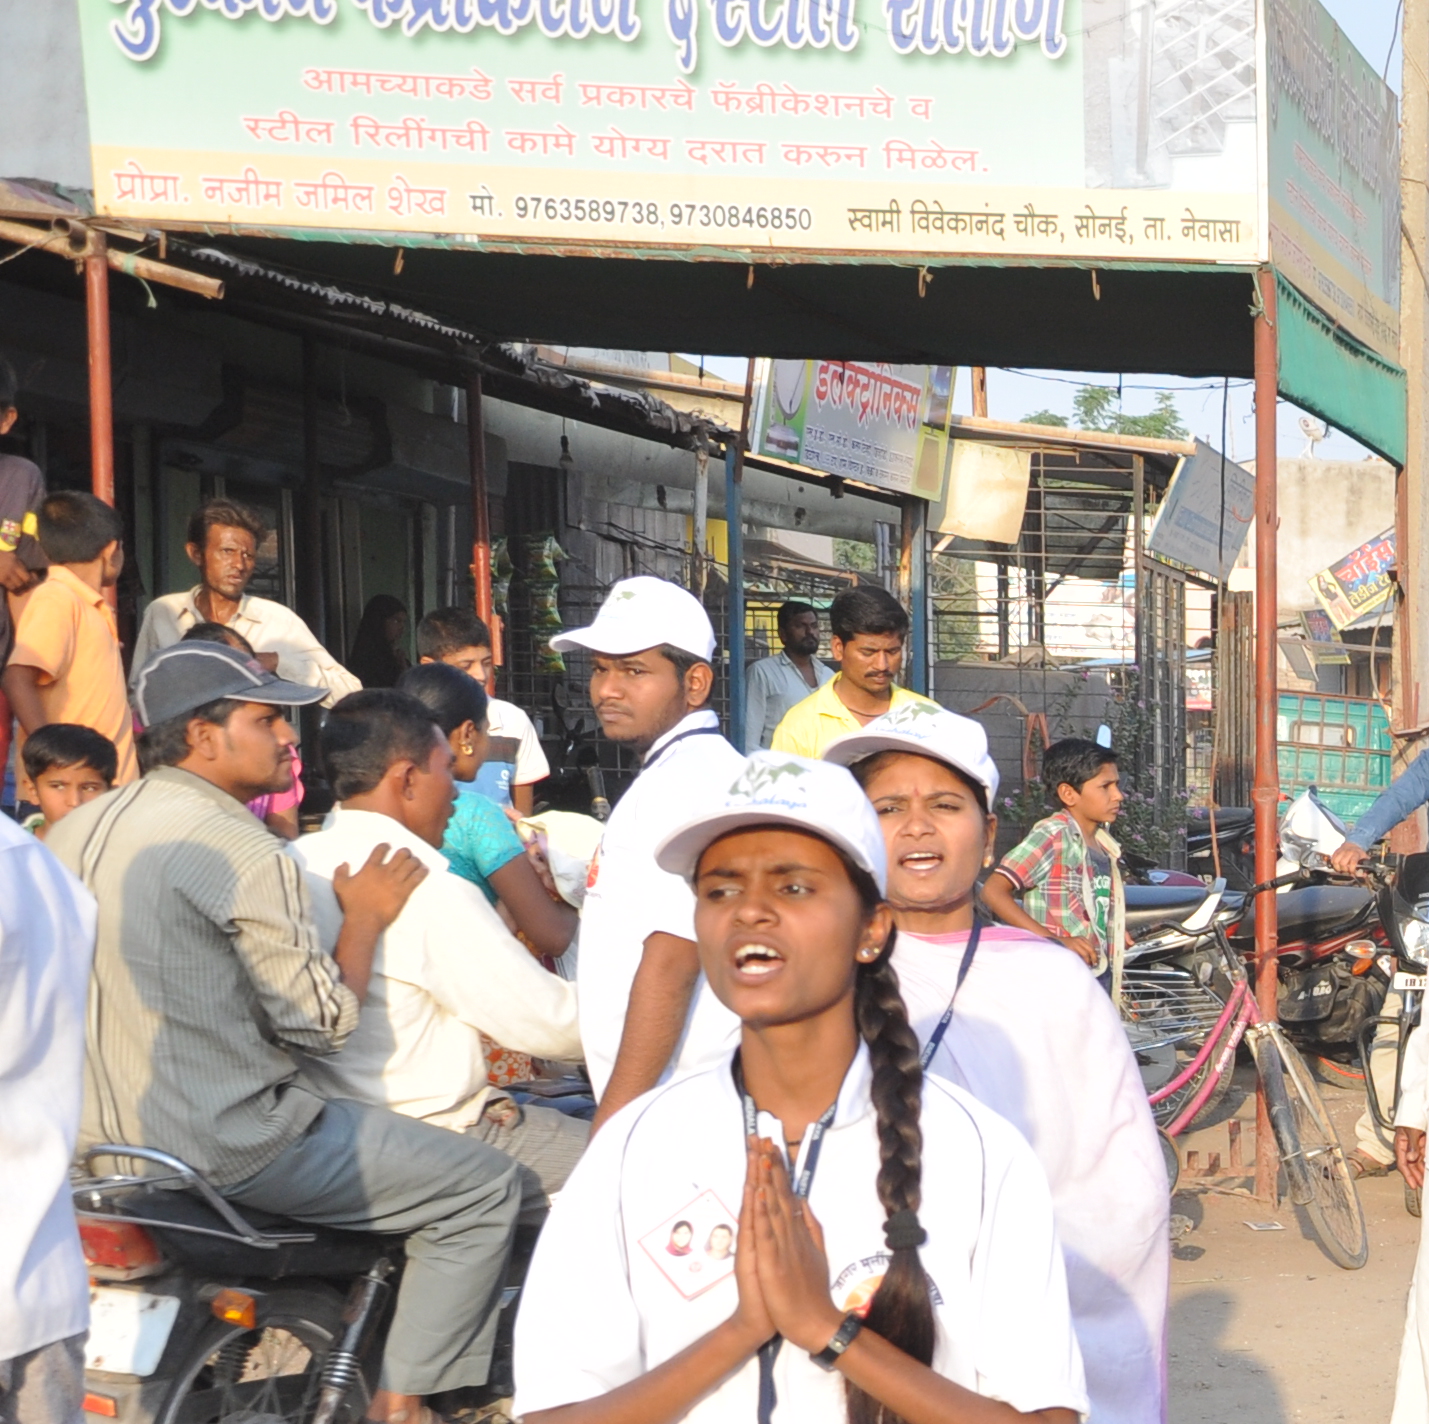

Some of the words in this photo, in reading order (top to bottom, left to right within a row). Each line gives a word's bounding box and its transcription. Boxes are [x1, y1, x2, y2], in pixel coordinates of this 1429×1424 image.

[302, 67, 494, 101] आमच्याकडे
[508, 73, 563, 105] सर्व
[578, 77, 696, 112] प्रकारचे
[711, 81, 896, 121] फॅब्रीकेशनचे
[909, 96, 934, 121] व
[242, 111, 333, 145] स्टील
[352, 115, 490, 153] रिलींगची
[506, 125, 576, 157] कामे
[591, 129, 672, 162] योग्य
[685, 139, 767, 167] दरात
[782, 145, 867, 170] करुन
[882, 141, 990, 174] मिळेल.
[113, 161, 189, 203] प्रोप्रा.
[202, 168, 283, 208] नजीम
[294, 172, 375, 212] जमिल
[388, 176, 447, 216] शेख
[469, 187, 503, 218] मो.
[514, 195, 812, 232] 9763589738,9730846850
[847, 199, 902, 235] स्वामी
[910, 201, 1006, 240] विवेकानंद
[1013, 204, 1065, 244] चौक,
[1074, 206, 1134, 246] सोनई,
[1143, 215, 1172, 242] ता.
[1181, 208, 1241, 244] नेवासा
